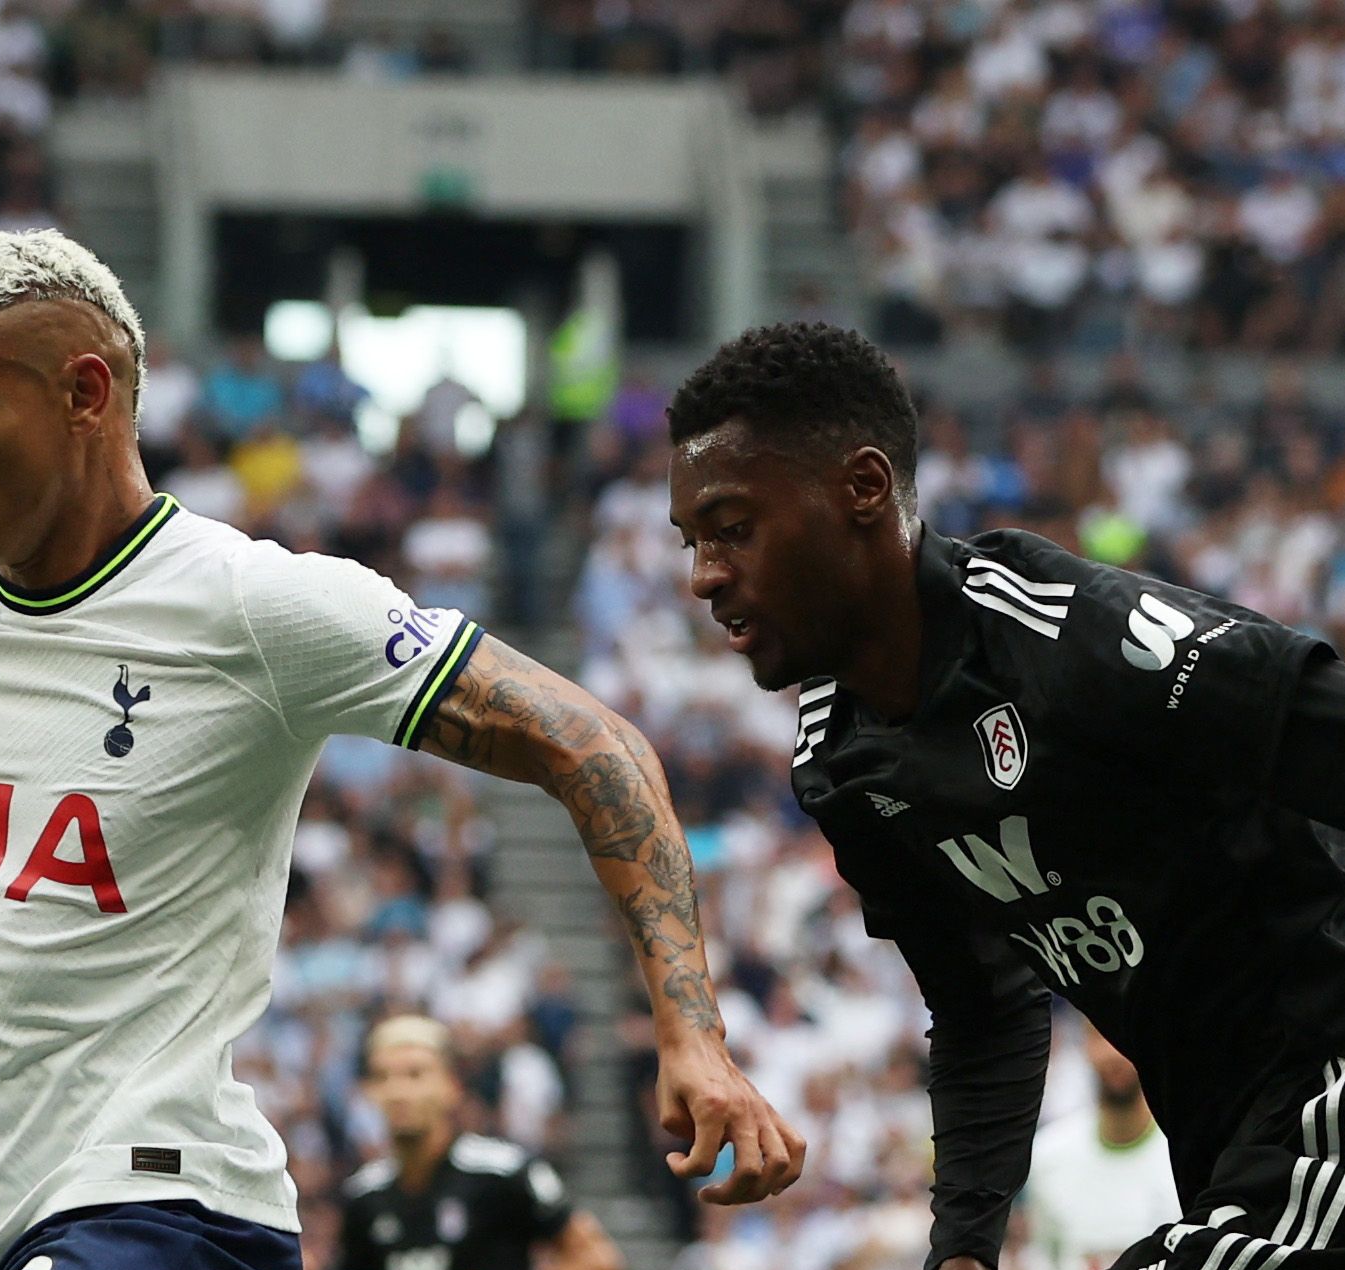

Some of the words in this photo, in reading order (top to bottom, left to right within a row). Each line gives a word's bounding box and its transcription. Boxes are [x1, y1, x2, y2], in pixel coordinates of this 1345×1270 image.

[1166, 649, 1200, 710] WORLD
[1196, 618, 1238, 644] MOBIL
[991, 719, 1017, 773] FFC
[1009, 895, 1145, 988] W88
